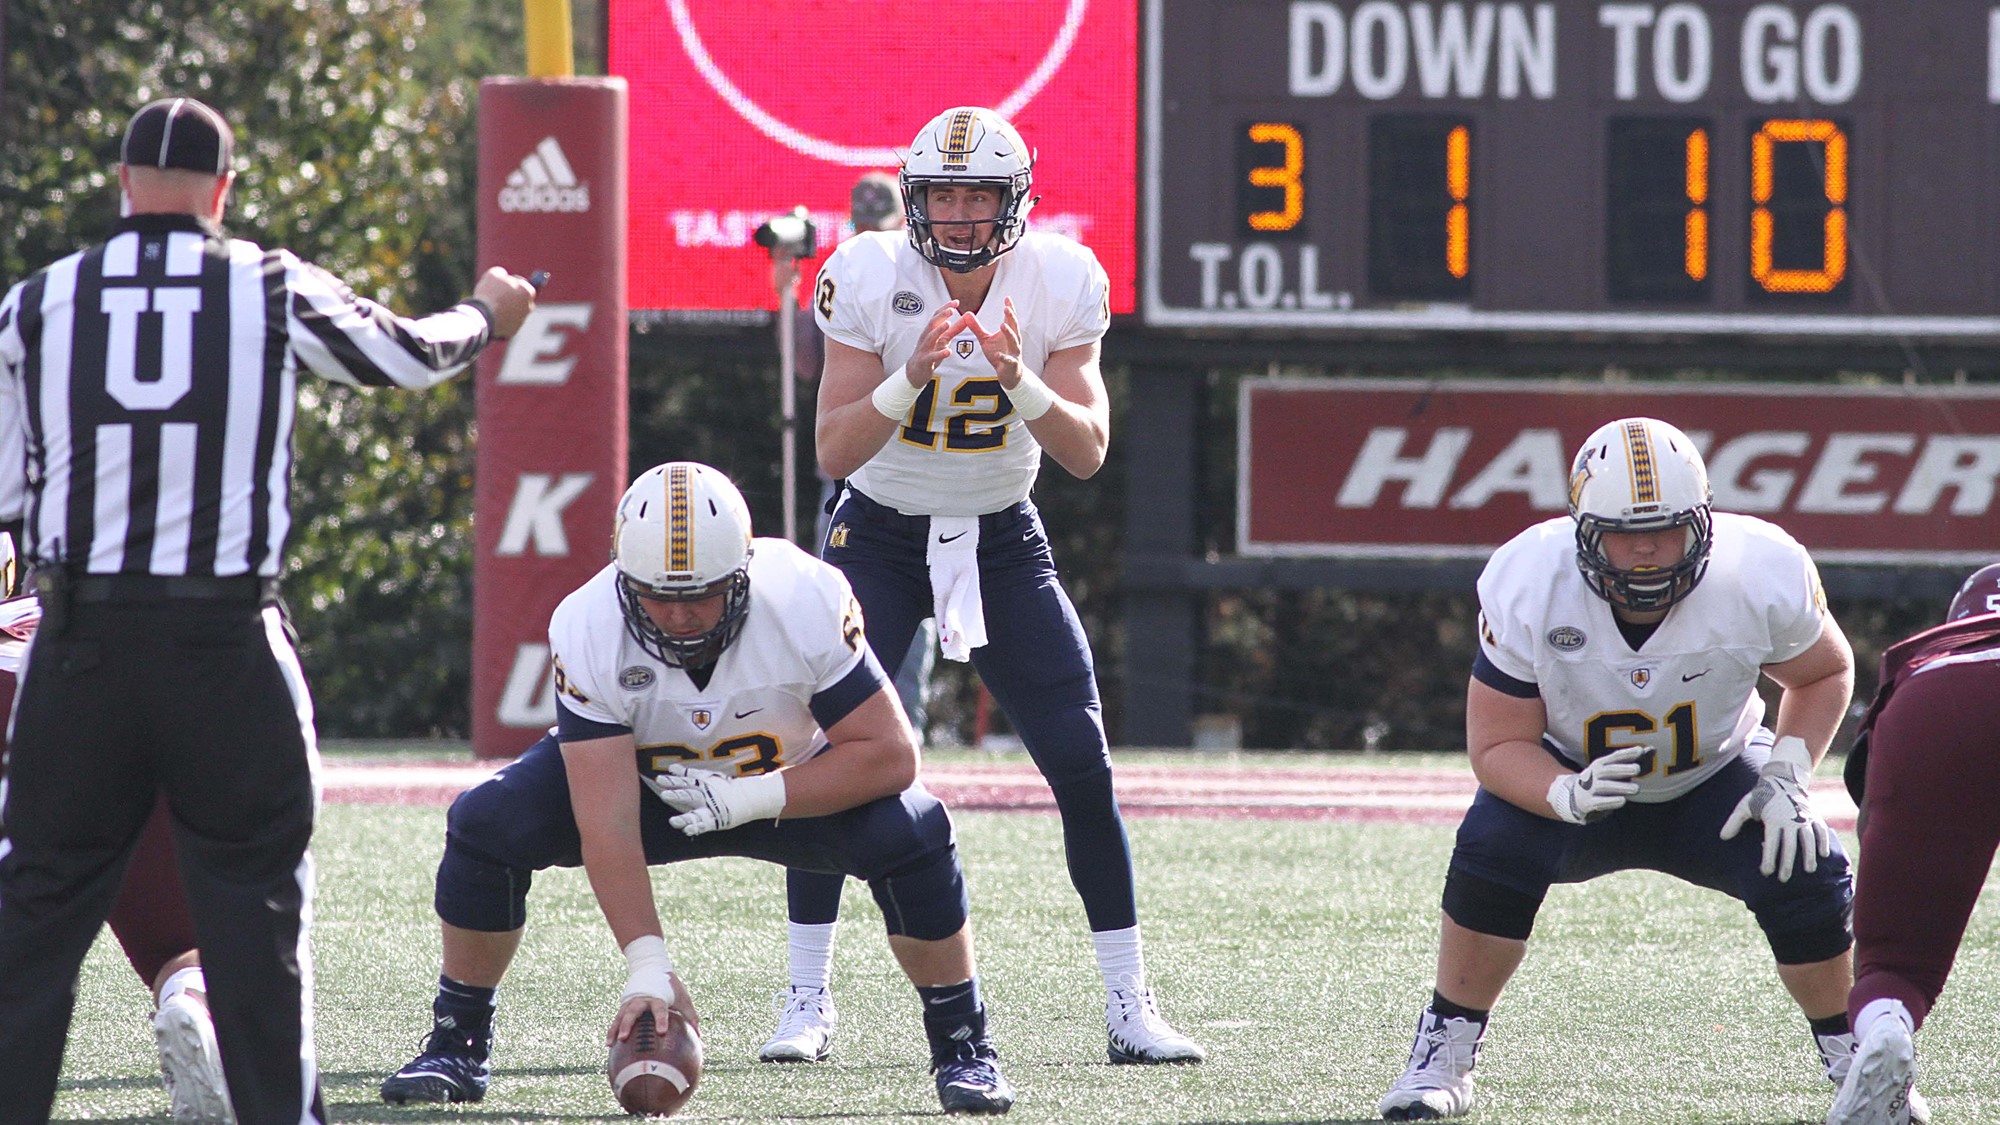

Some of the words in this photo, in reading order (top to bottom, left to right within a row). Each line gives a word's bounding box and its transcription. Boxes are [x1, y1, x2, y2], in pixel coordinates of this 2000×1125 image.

[1289, 2, 1556, 100] DOWN
[1600, 3, 1711, 103] TO
[1740, 4, 1862, 104] GO
[498, 184, 591, 213] adidas
[942, 164, 967, 172] SPEED
[1248, 123, 1305, 231] 3
[1446, 126, 1470, 279] 1
[1685, 119, 1848, 293] 10
[1190, 244, 1352, 309] T.O.L.
[100, 286, 202, 411] U
[897, 375, 1015, 452] 12
[1336, 427, 2000, 516] HAGER
[1632, 505, 1659, 514] SPEED
[666, 574, 693, 582] SPEED
[1583, 700, 1704, 778] 61
